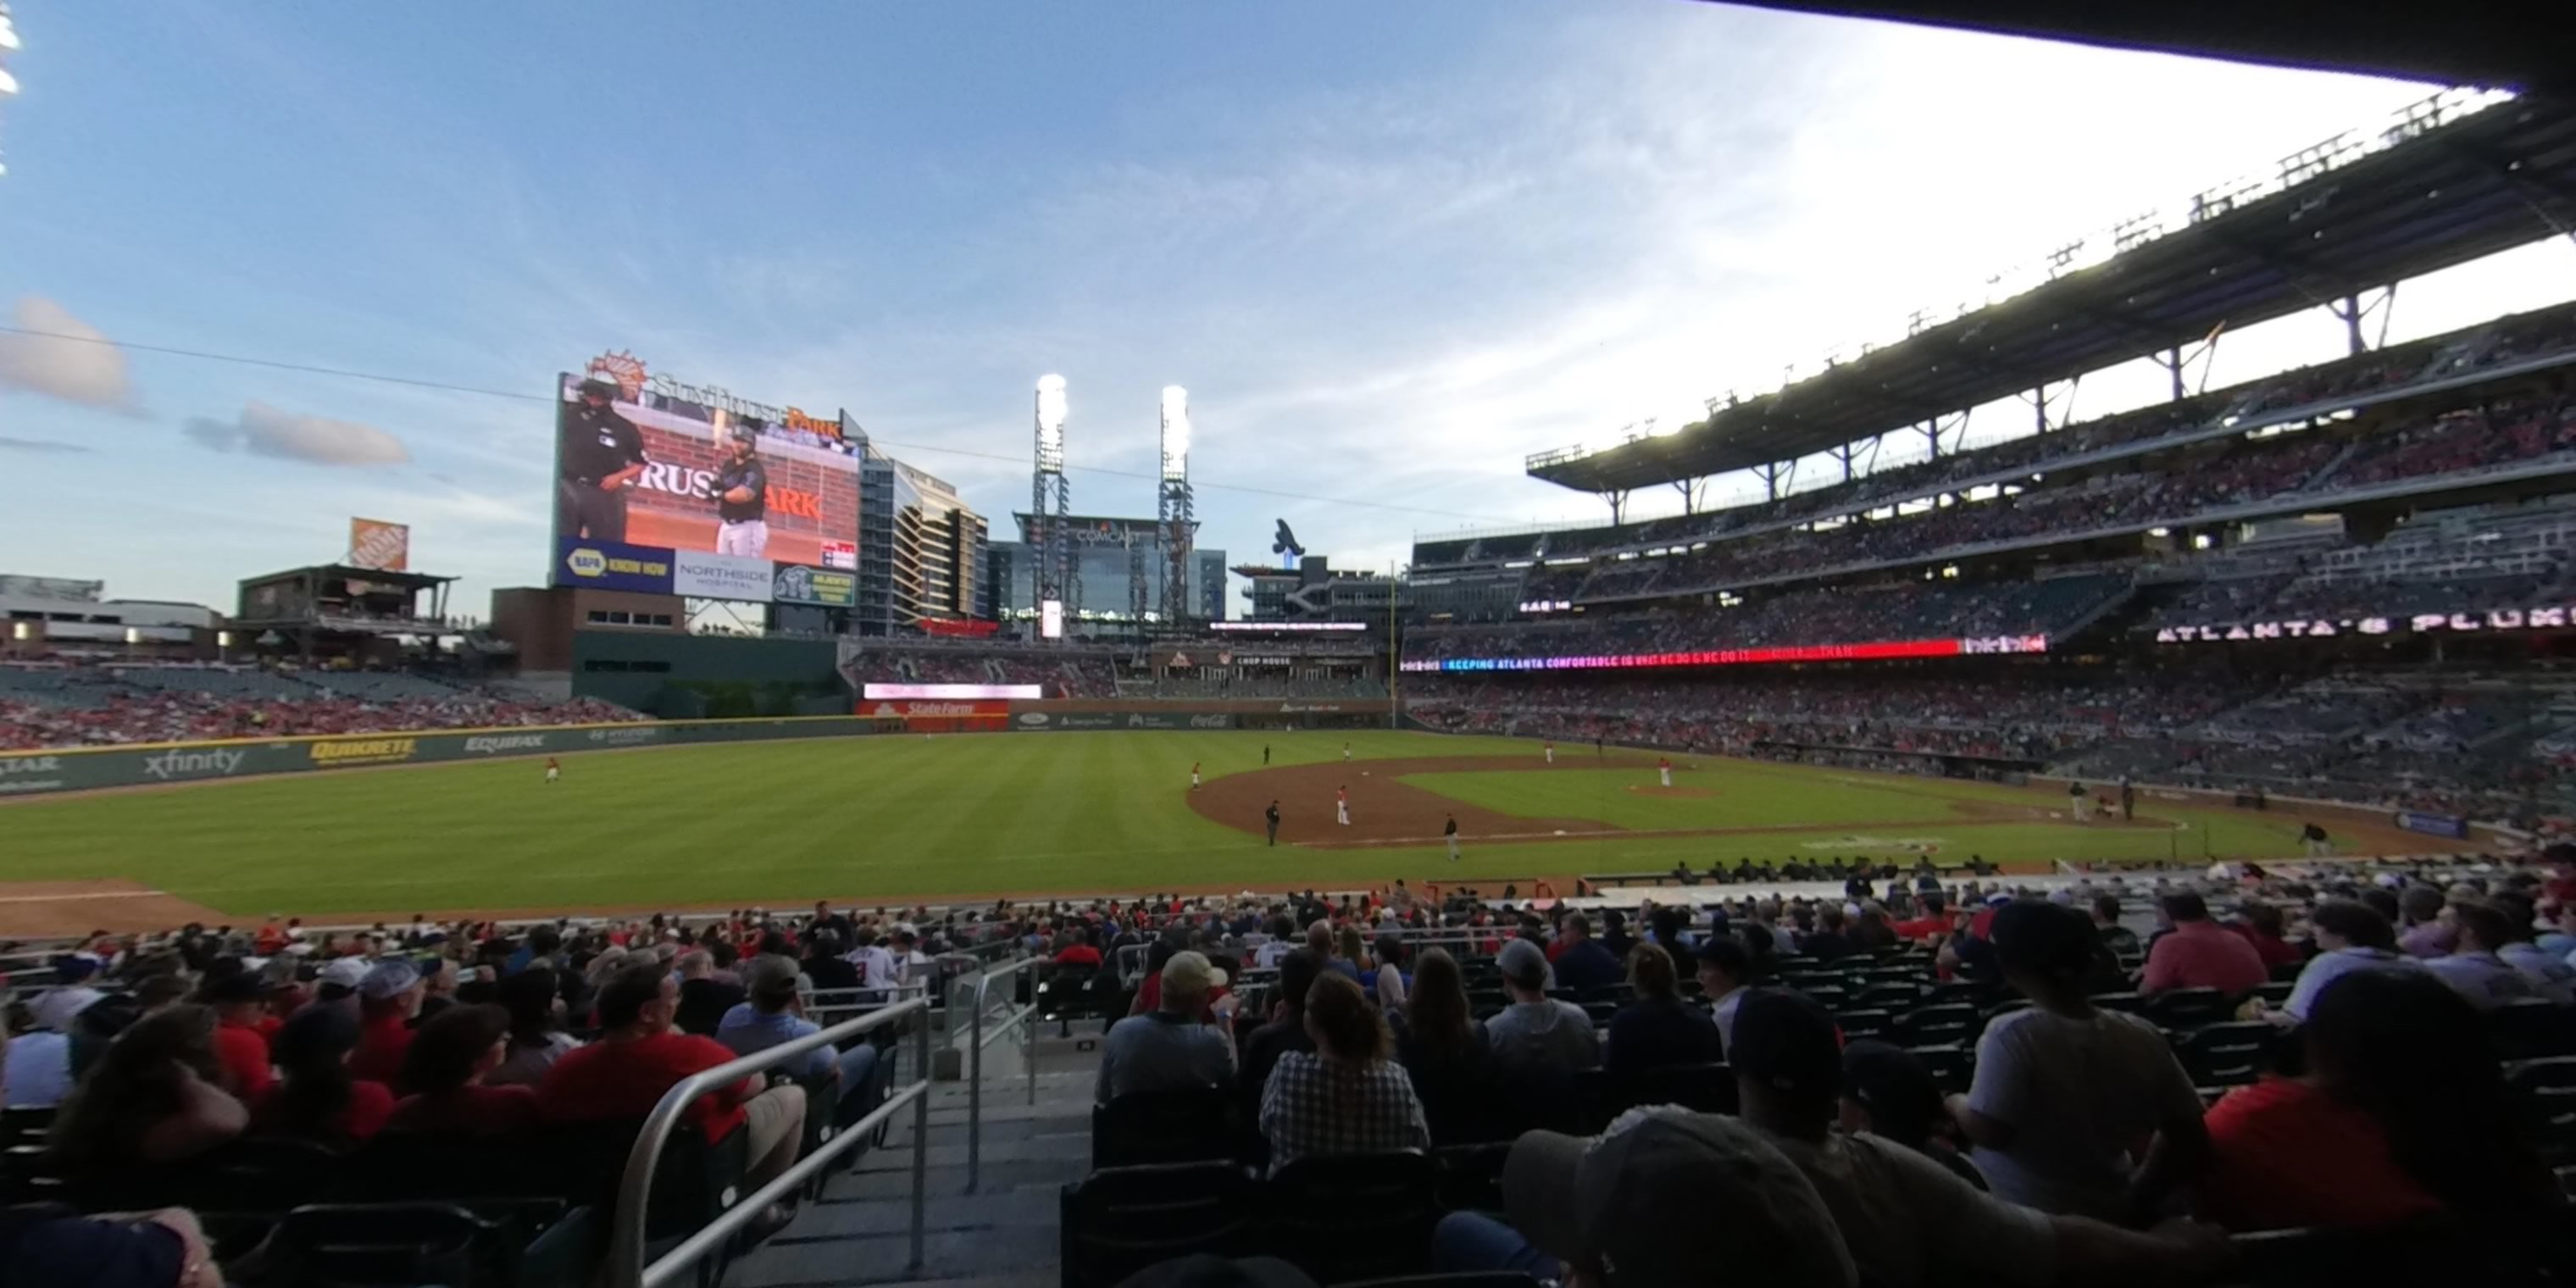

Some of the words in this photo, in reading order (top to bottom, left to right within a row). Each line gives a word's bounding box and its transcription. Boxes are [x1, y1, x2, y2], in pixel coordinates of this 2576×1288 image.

[1076, 530, 1140, 543] COMCAST
[575, 556, 600, 569] NAPA
[680, 564, 768, 582] NORTHSIDE
[697, 578, 752, 590] HOSPITAL
[1448, 658, 1494, 670] KEEPING
[1497, 658, 1543, 669] ATLANTA
[1546, 656, 1618, 669] COMFORTABLE
[310, 739, 417, 758] QUIKRETE
[465, 735, 545, 752] EQUIFAX
[144, 748, 244, 779] xfinity
